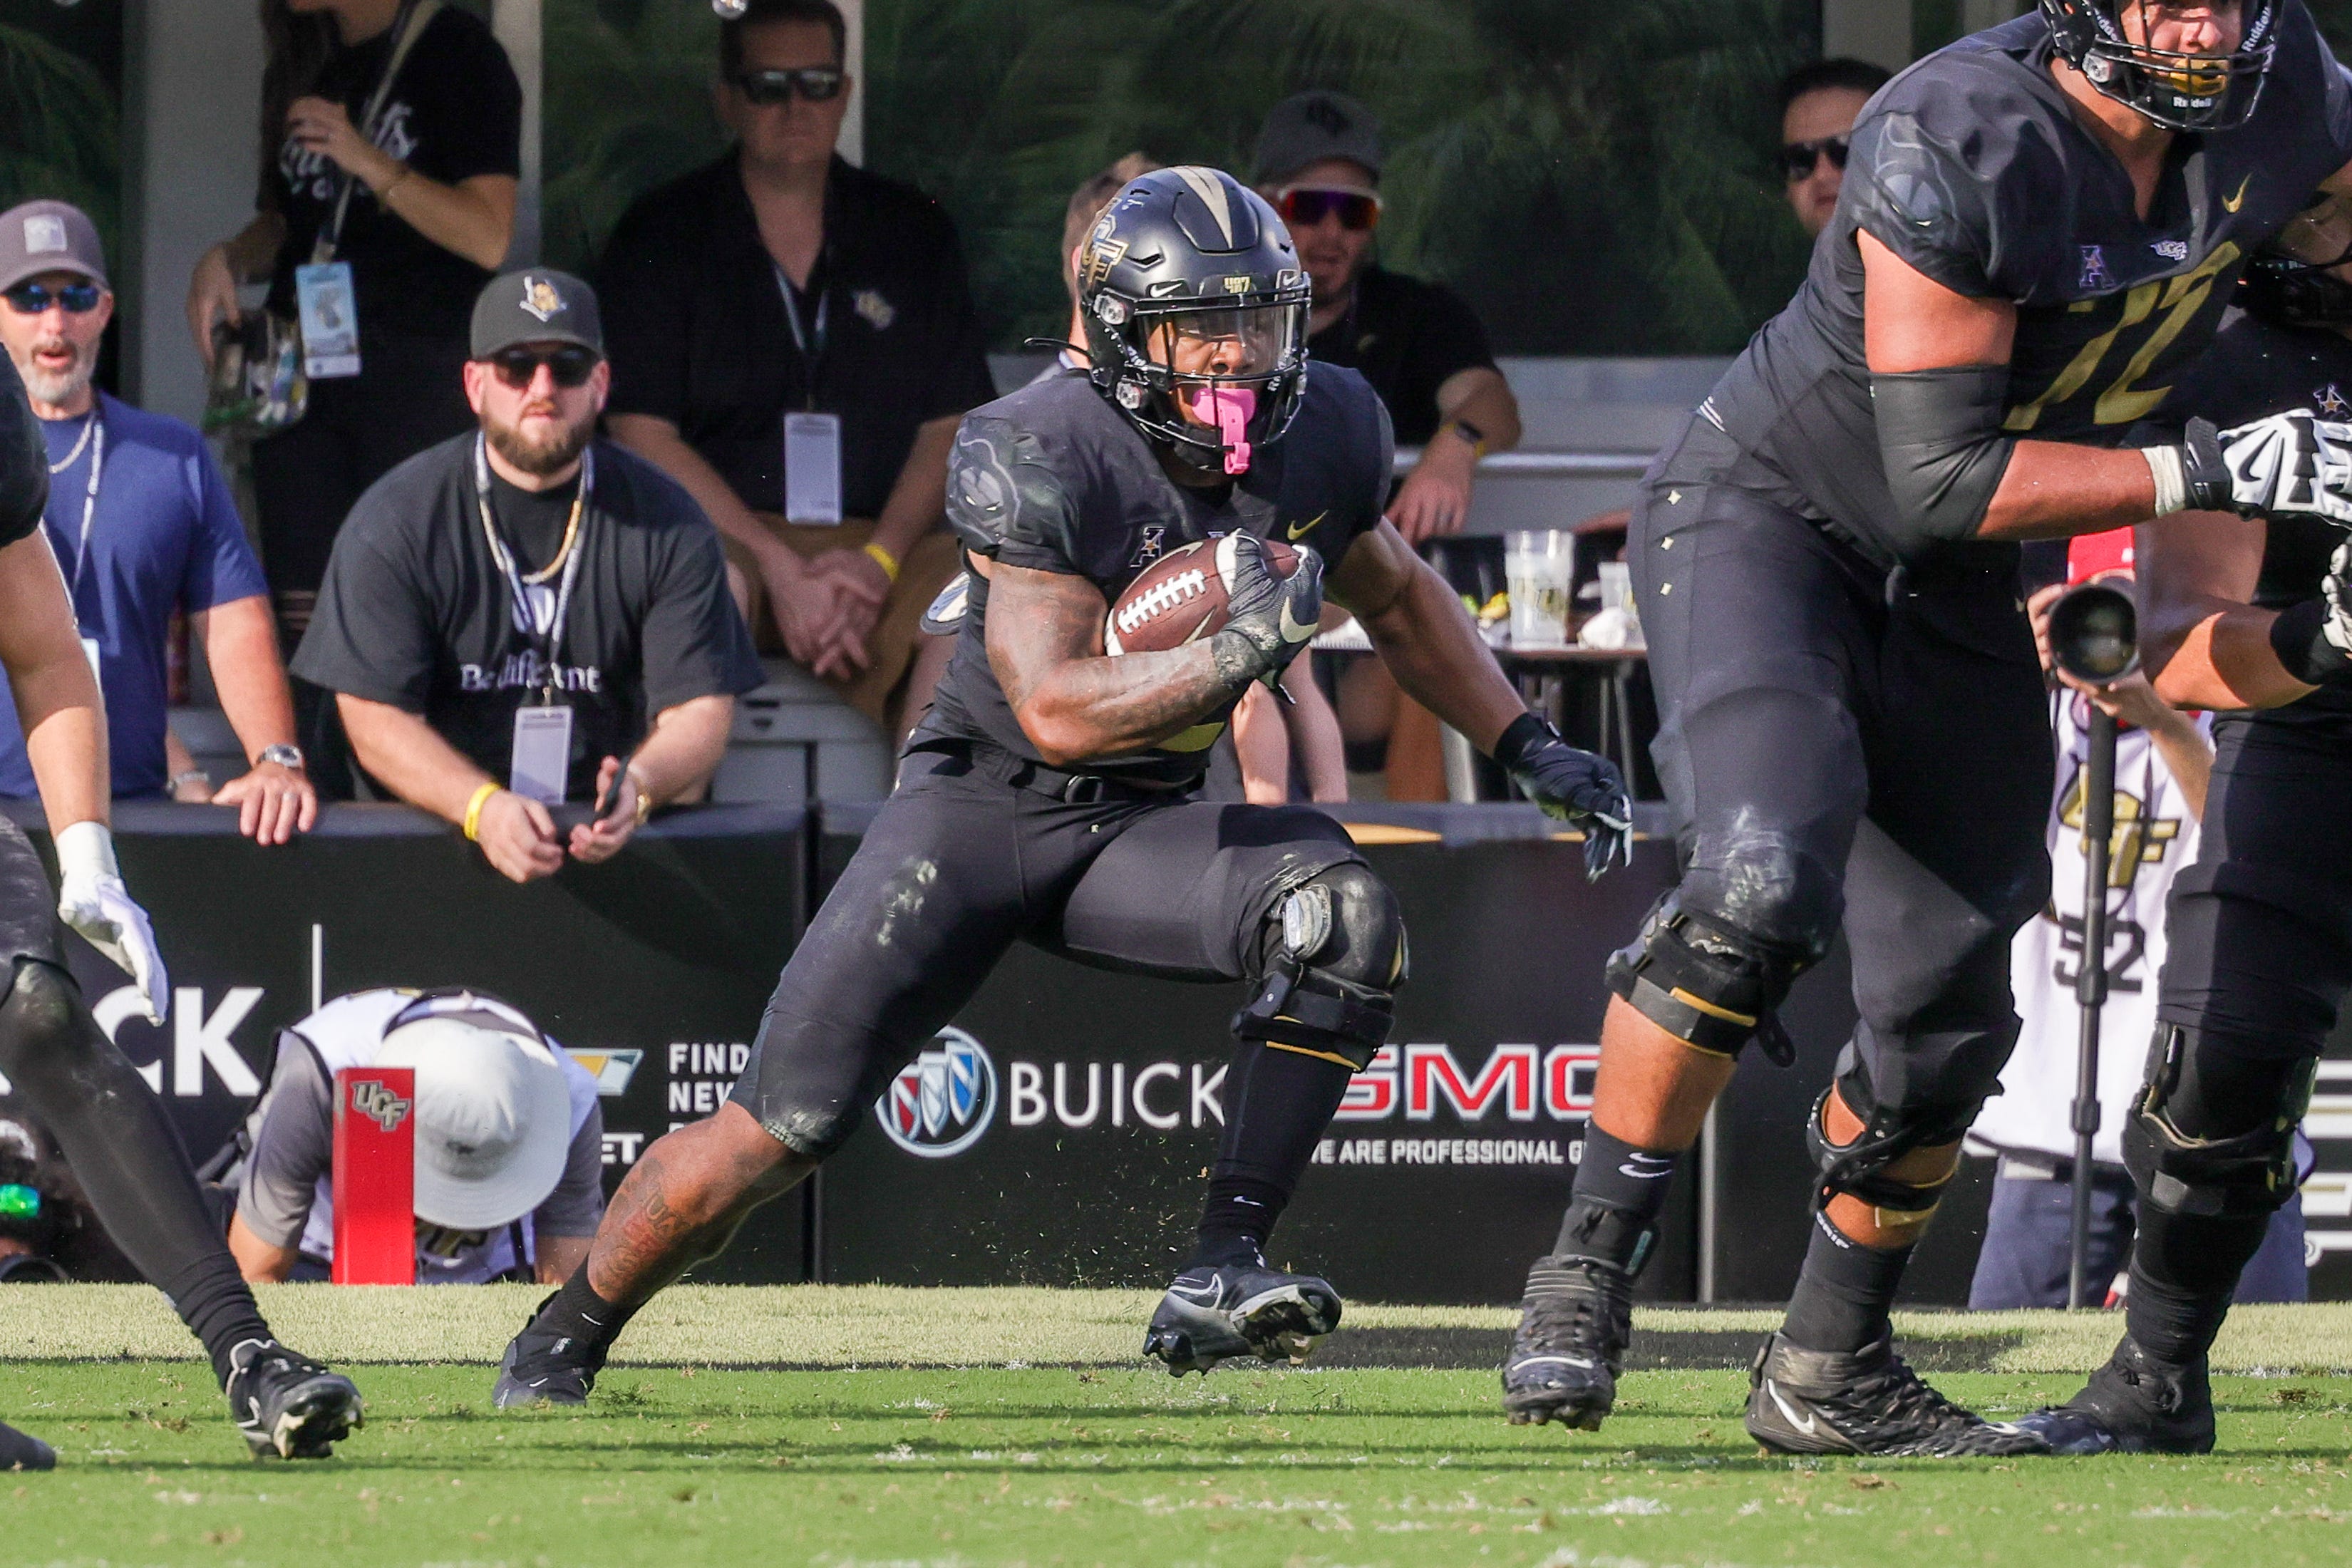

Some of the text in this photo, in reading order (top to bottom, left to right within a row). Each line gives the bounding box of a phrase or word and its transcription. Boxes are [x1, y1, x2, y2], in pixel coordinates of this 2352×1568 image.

[2173, 96, 2212, 108] Ridell
[2150, 239, 2187, 261] UCF
[2001, 241, 2240, 432] 72
[2053, 911, 2145, 994] 52
[668, 1043, 751, 1075] FIND
[351, 1080, 411, 1132] UCF
[1010, 1061, 1229, 1129] BUICK
[1310, 1139, 1335, 1164] E
[1339, 1139, 1387, 1164] ARE
[1391, 1139, 1564, 1165] PROFESSIONAL
